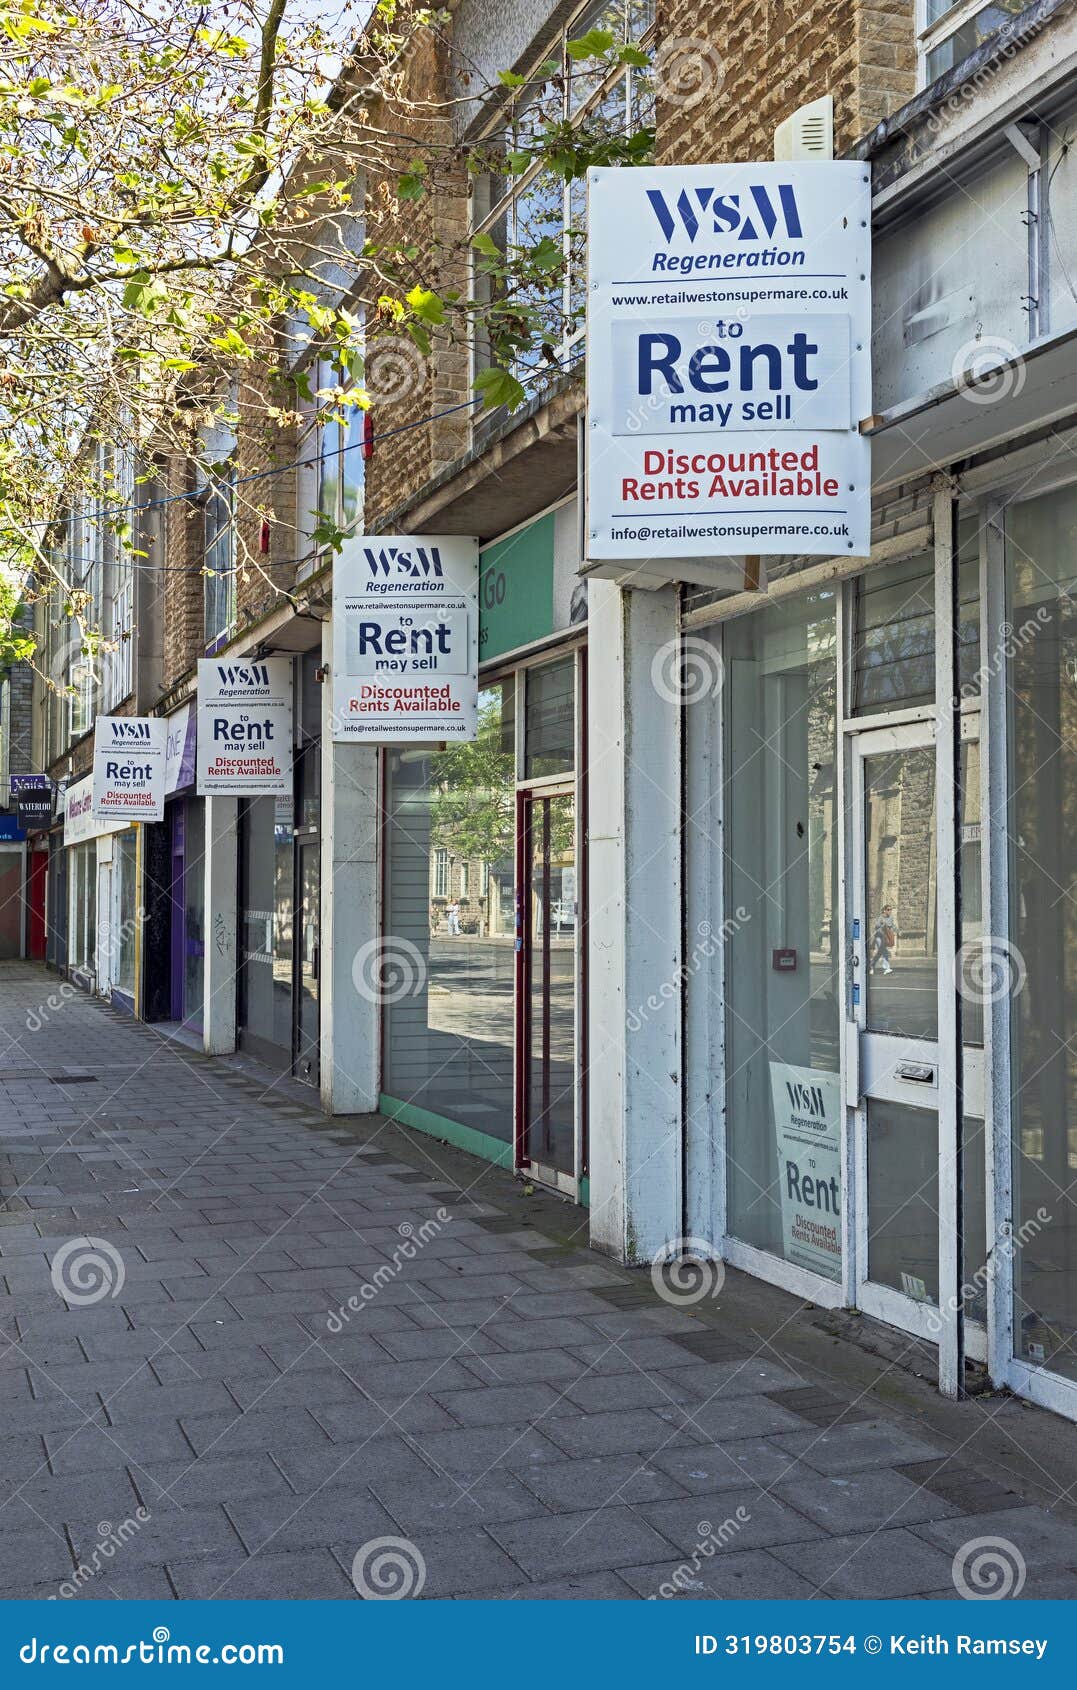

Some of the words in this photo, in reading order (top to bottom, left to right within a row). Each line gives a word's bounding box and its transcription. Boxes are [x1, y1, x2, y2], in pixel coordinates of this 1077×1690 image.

[652, 248, 806, 275] Regeneration
[612, 287, 849, 306] www.retailwestonsupermare.co.uk
[716, 319, 744, 339] to
[638, 333, 819, 395] Rent
[670, 401, 733, 427] may
[742, 395, 792, 420] sell
[644, 444, 819, 476] Discounted
[622, 477, 700, 501] Rents
[708, 472, 839, 499] Available
[611, 524, 849, 541] info@retailwestonsupermare.co.uk
[366, 581, 445, 594] Regeneration
[345, 602, 467, 611] www.retailwestonsupermare.co.uk
[399, 616, 413, 626] to
[359, 622, 451, 655] Rent
[375, 659, 407, 672] may
[412, 656, 437, 670] sell
[219, 688, 270, 697] Regeneration
[361, 684, 450, 699] Discounted
[349, 700, 390, 712] Rents
[393, 699, 461, 712] Available
[240, 714, 249, 722] to
[213, 718, 274, 741] Rent
[344, 724, 466, 733] info@retailwestonsupermare.co.uk
[111, 739, 151, 747] Regeneration
[224, 743, 245, 752] may
[248, 741, 265, 751] sell
[215, 757, 274, 767] Discounted
[106, 762, 152, 780] Rent
[208, 767, 234, 776] Rents
[237, 765, 281, 775] Available
[132, 780, 146, 788] sell
[100, 798, 122, 806] Rents
[123, 798, 157, 807] Available
[106, 791, 152, 800] Discounted
[19, 802, 51, 811] WATERLOO
[791, 1114, 828, 1132] Regeneration
[786, 1160, 840, 1217] Rent
[795, 1214, 837, 1241] Discounted
[791, 1225, 810, 1243] Rents
[811, 1233, 842, 1257] Available
